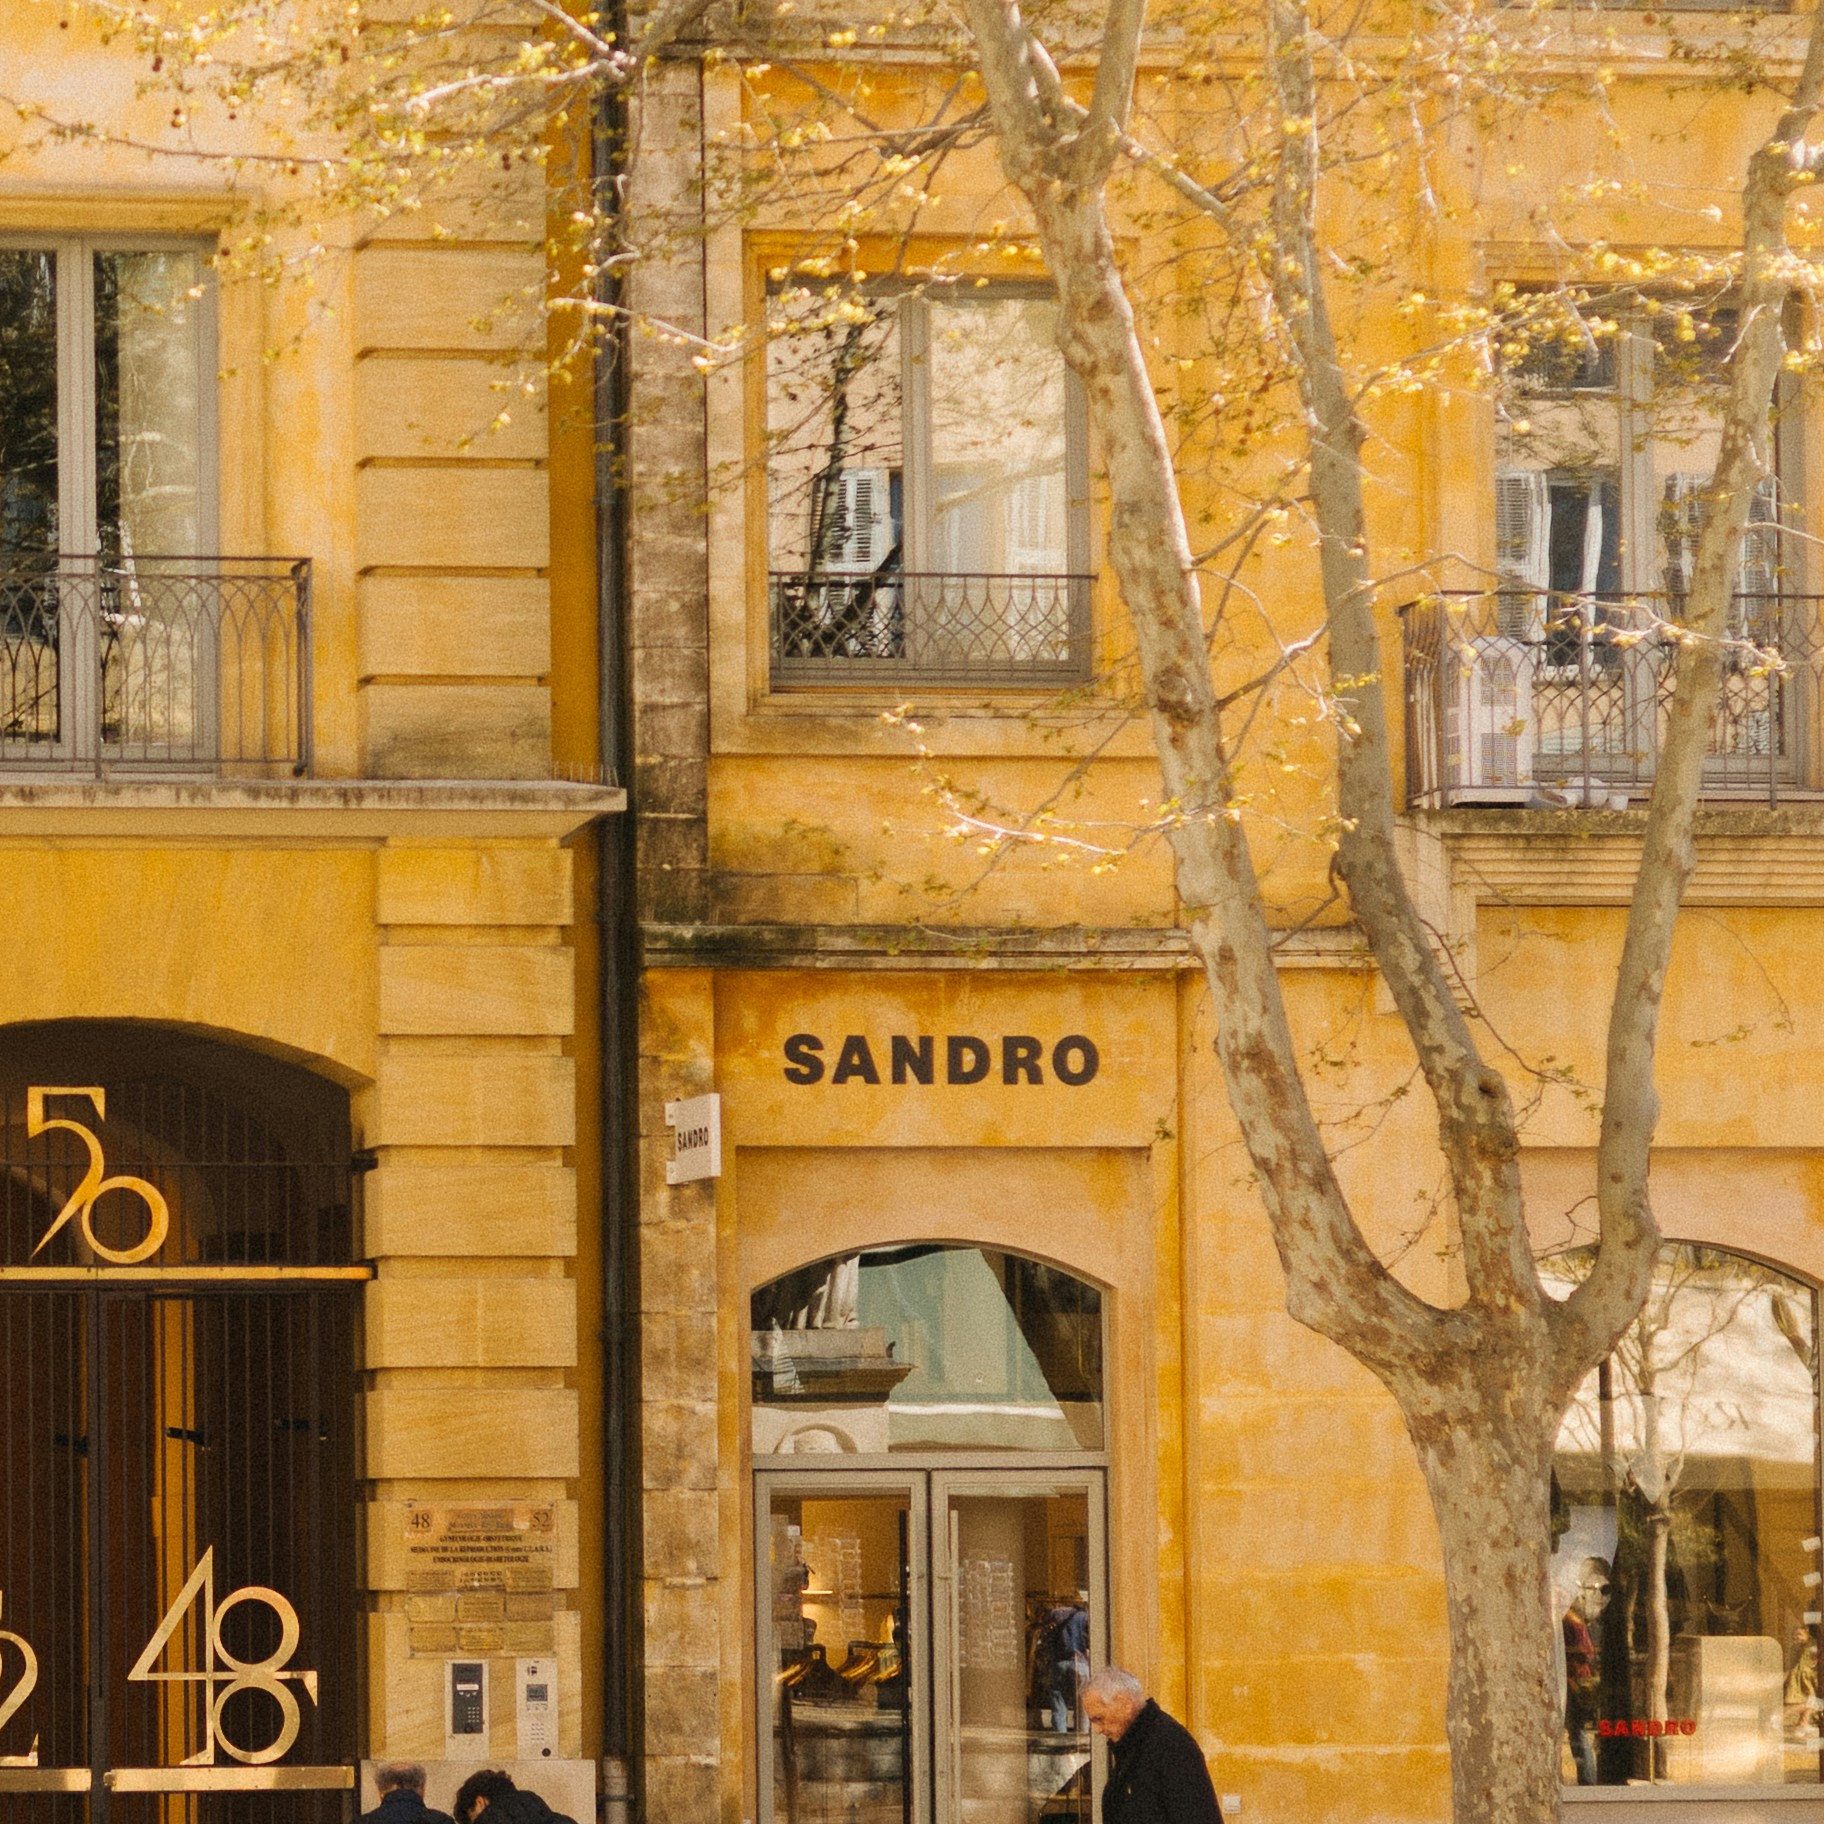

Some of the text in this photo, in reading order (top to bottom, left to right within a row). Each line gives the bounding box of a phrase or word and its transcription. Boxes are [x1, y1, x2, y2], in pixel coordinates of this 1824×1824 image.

[783, 1033, 1100, 1086] SANDRO
[677, 1126, 709, 1153] SANDRO
[27, 1086, 169, 1264] 50
[411, 1513, 430, 1529] 48
[532, 1511, 550, 1528] 52
[127, 1544, 318, 1766] 48
[1598, 1718, 1697, 1737] SANDRO
